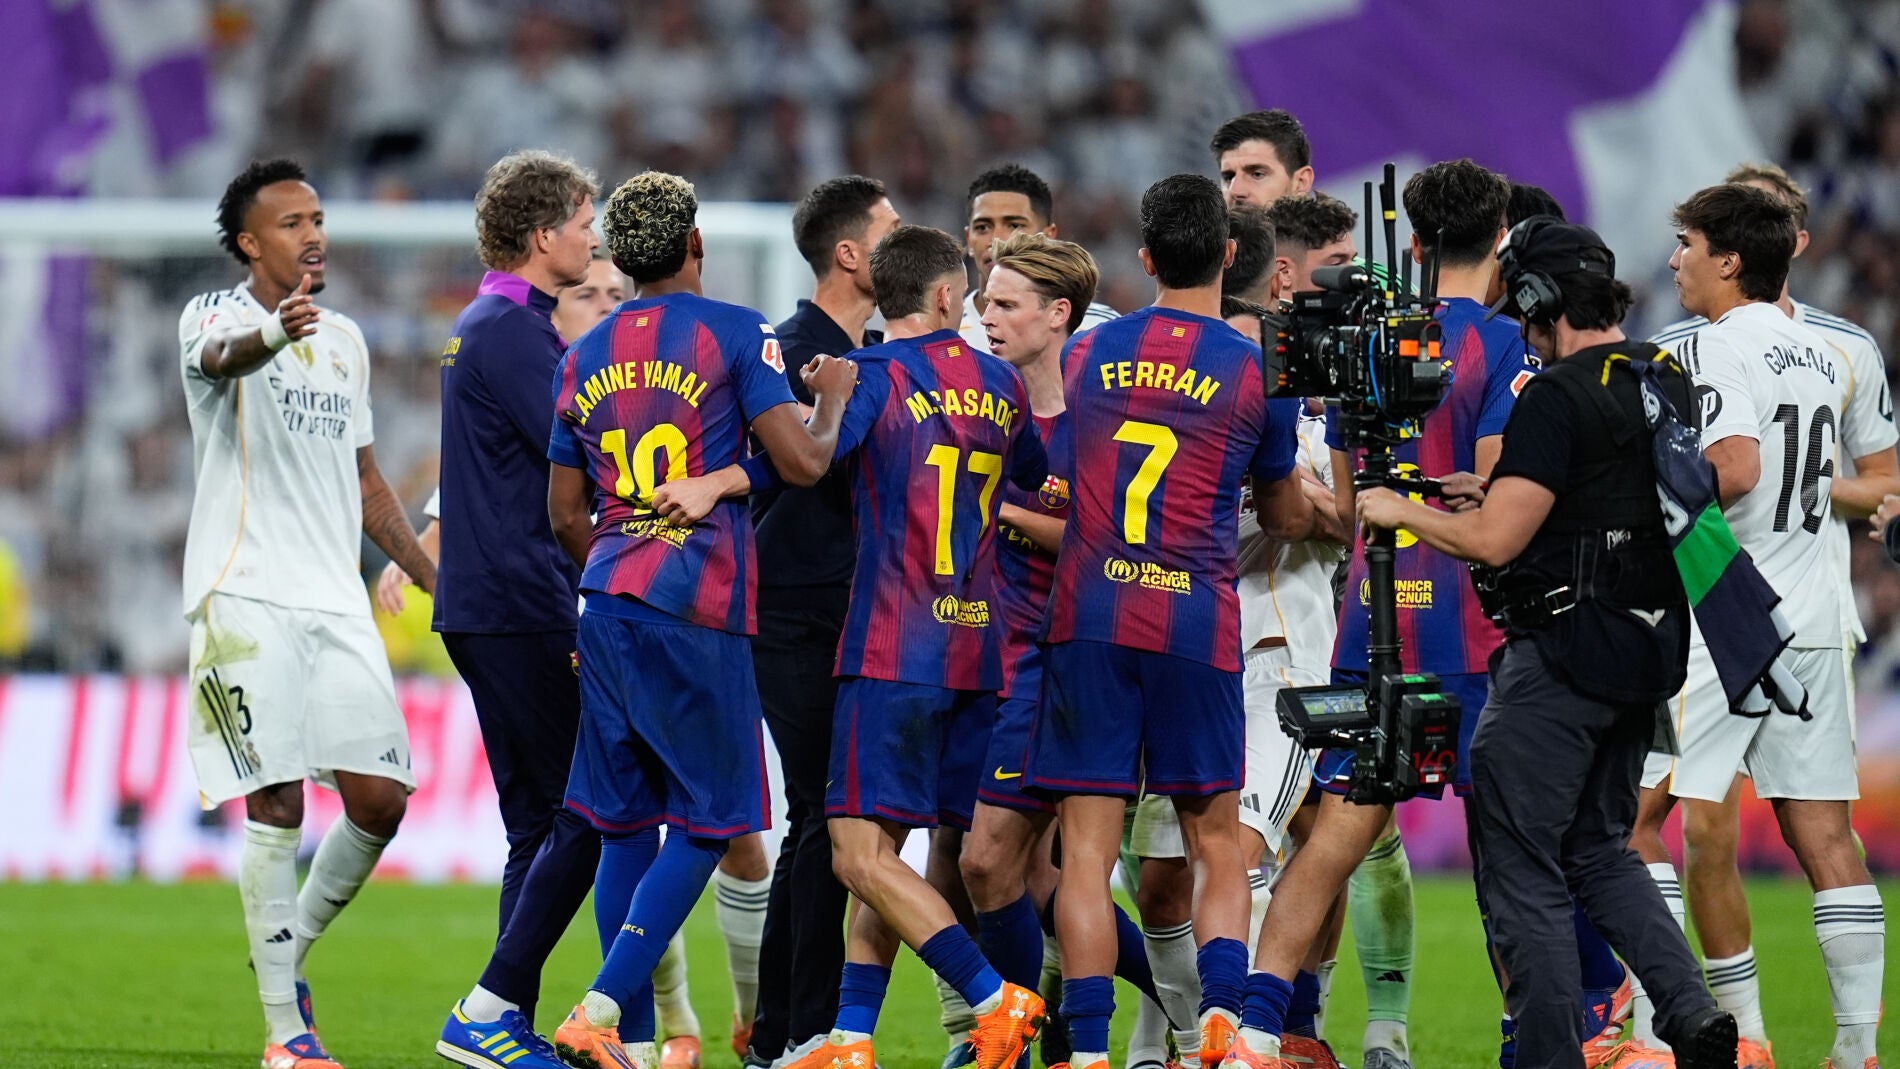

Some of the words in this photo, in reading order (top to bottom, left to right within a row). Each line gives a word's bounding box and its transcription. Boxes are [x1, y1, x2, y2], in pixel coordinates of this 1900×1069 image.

[566, 361, 637, 427] LAMINE
[643, 360, 708, 408] YAMAL
[1100, 361, 1220, 405] FERRAN
[600, 423, 689, 516] 10
[1112, 420, 1178, 544] 7
[1772, 403, 1836, 535] 16
[924, 443, 1003, 576] 17
[1140, 573, 1191, 591] ACNUR
[1396, 592, 1432, 603] CNUR
[229, 685, 252, 735] 3
